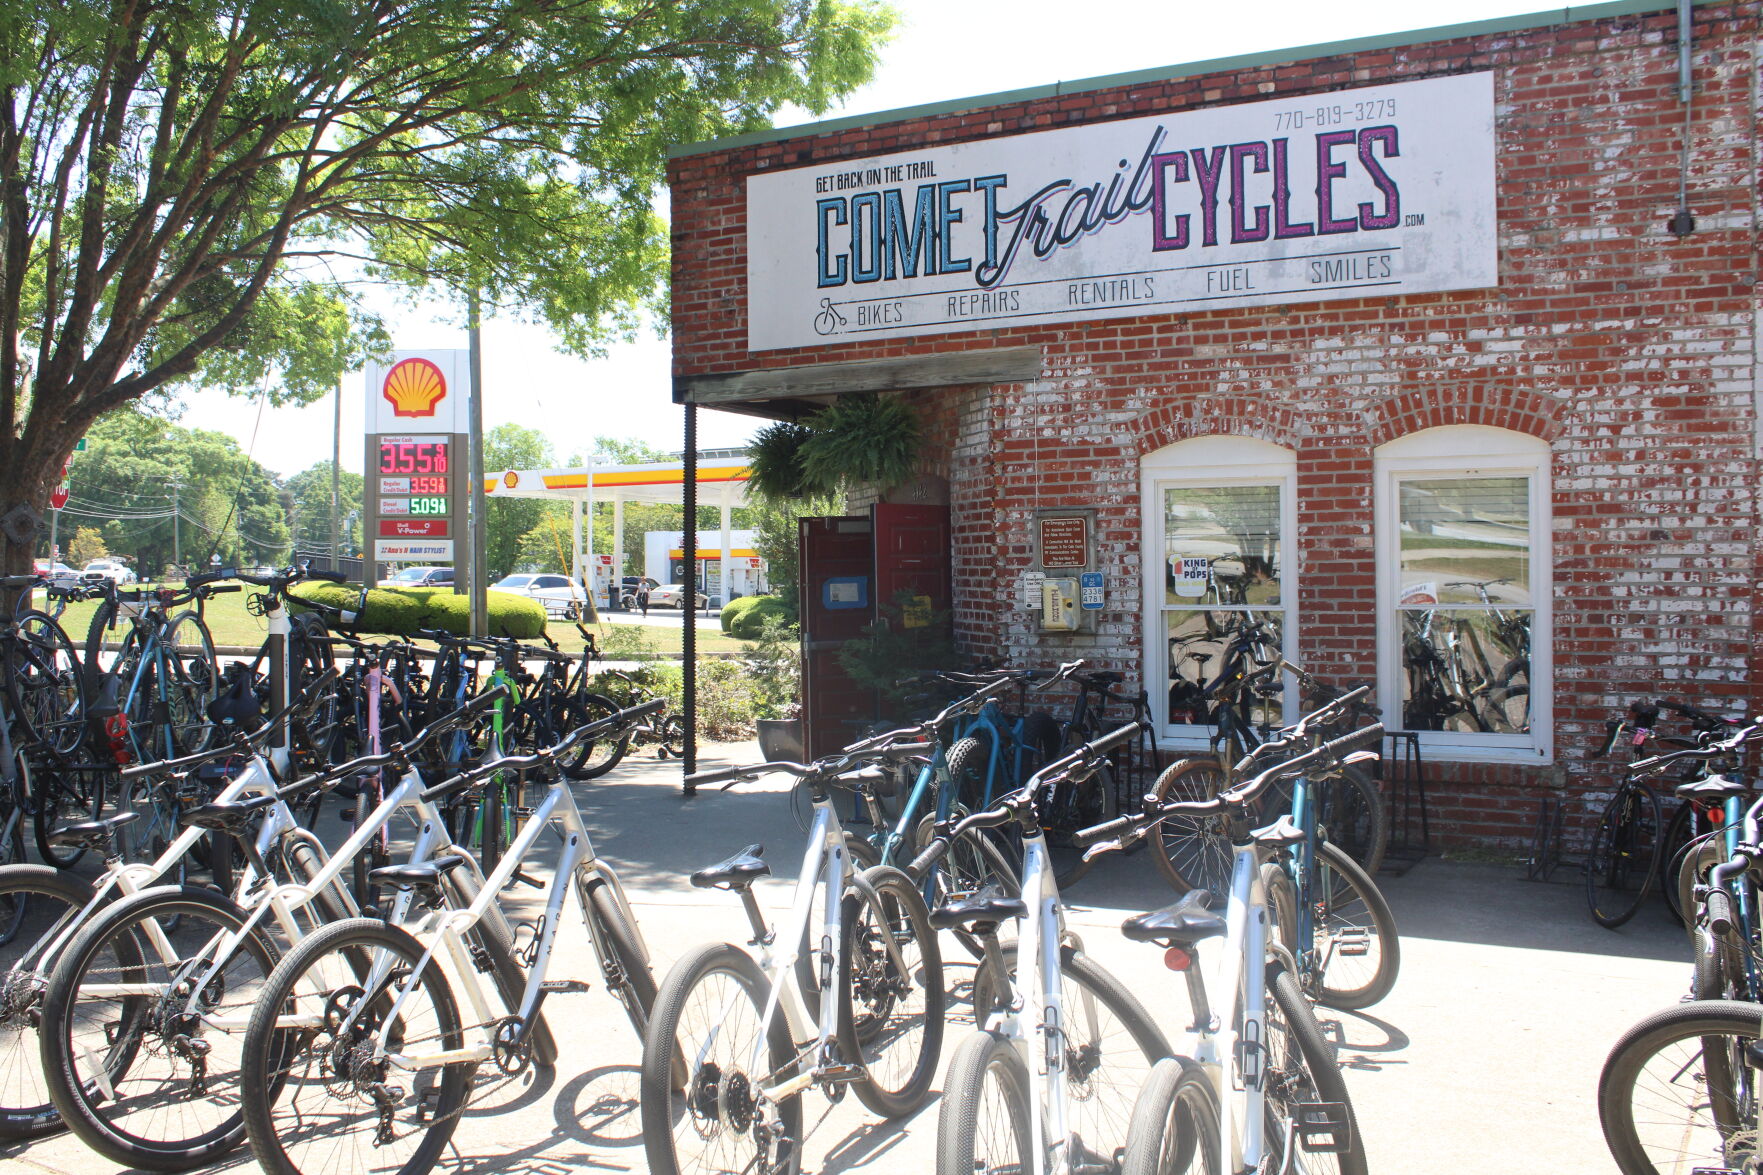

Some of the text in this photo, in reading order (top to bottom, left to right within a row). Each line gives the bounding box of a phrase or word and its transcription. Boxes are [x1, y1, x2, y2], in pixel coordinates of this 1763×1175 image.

[1274, 99, 1396, 131] 770-819-3279
[816, 160, 936, 193] GET BACK ON THE TRAIL
[816, 124, 1400, 291] COMET Trail CYCLES
[1402, 214, 1425, 227] .COM
[858, 255, 1391, 326] BIKES REPAIRS RENTALS FUEL SMILES
[411, 498, 438, 514] 5.09
